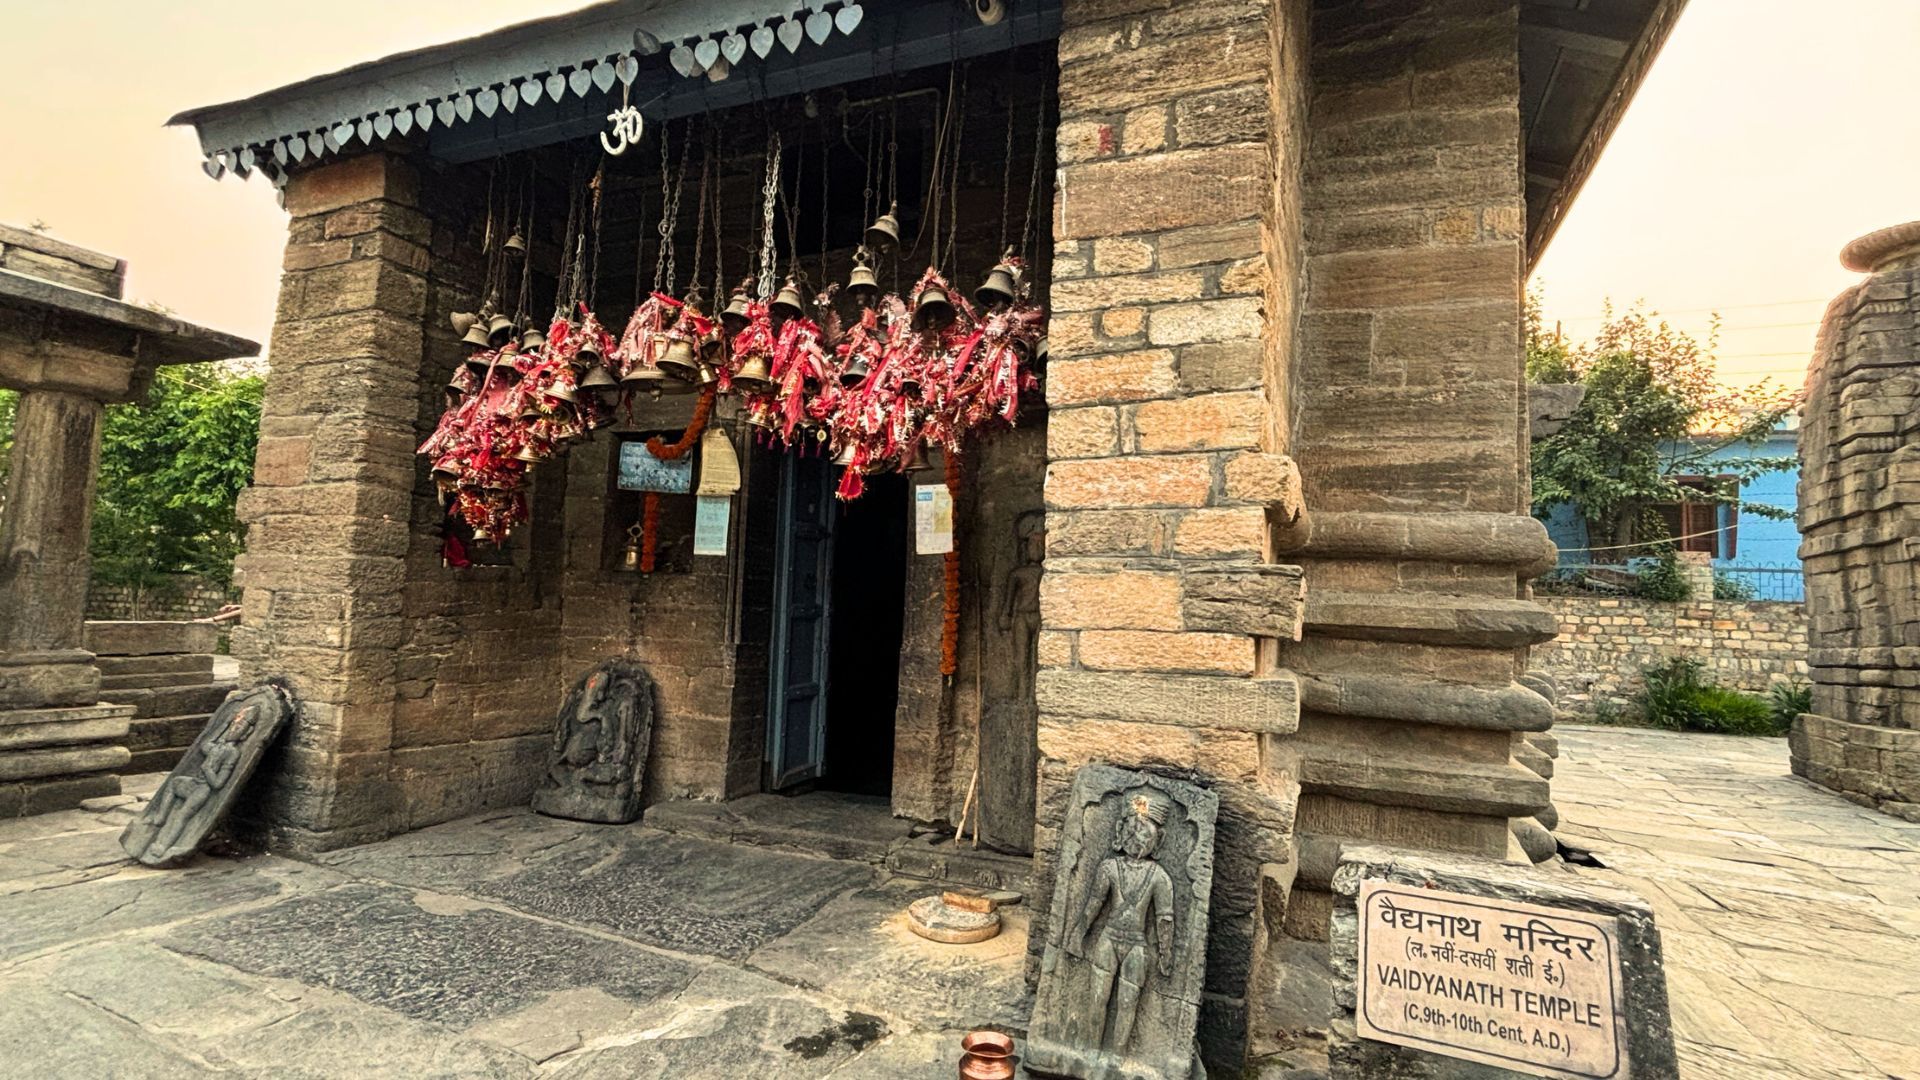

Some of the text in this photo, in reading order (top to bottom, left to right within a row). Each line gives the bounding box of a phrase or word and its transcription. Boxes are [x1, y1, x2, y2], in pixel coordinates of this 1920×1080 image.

[1379, 896, 1595, 961] वैद्यनाथ मन्दिर
[1504, 954, 1534, 978] शती
[1377, 964, 1601, 1028] VAIDYANATH TEMPLE
[1532, 1028, 1570, 1057] A.D.)
